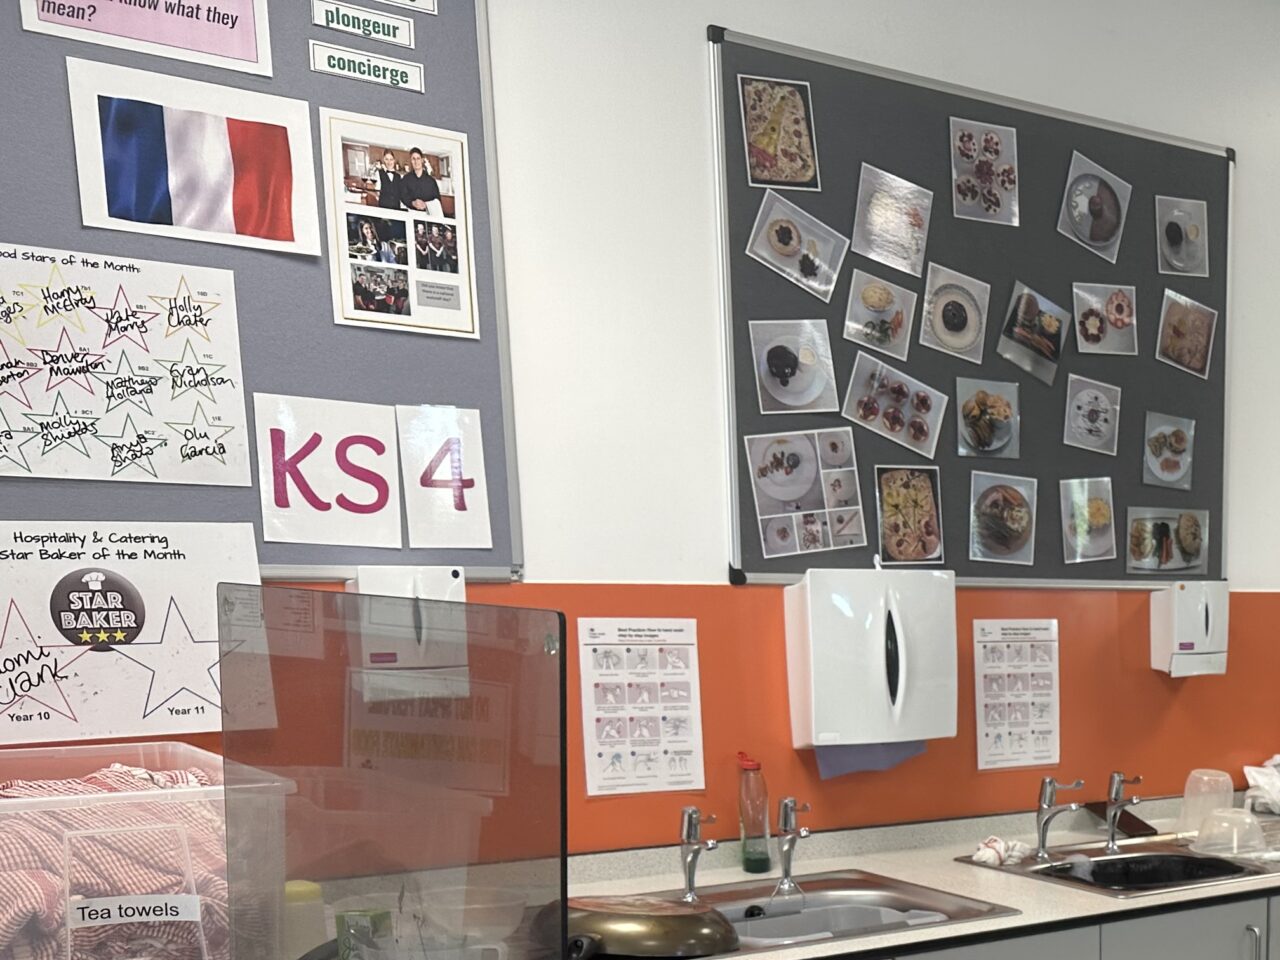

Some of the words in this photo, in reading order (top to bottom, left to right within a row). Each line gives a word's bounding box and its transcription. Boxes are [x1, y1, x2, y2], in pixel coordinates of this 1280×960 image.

[41, 0, 96, 21] mean?
[164, 0, 201, 20] what
[206, 9, 238, 29] they
[325, 7, 399, 38] plongeur
[327, 55, 408, 86] concierge
[0, 249, 17, 258] od
[22, 252, 56, 263] Stars
[61, 255, 76, 265] of
[81, 259, 99, 268] the
[0, 302, 23, 323] gers
[169, 296, 202, 317] Holly
[106, 308, 141, 324] Kate
[168, 313, 212, 328] Chater
[171, 374, 235, 390] Nicholson
[106, 386, 153, 400] Holland
[40, 415, 79, 432] Molly
[185, 427, 209, 440] Olu
[112, 434, 147, 454] Anya
[181, 440, 226, 460] Garcia
[270, 427, 390, 514] KS
[420, 437, 475, 511] 4
[14, 532, 86, 548] Hospitality
[92, 532, 103, 543] &
[109, 533, 168, 548] Catering
[0, 549, 33, 560] Star
[40, 550, 86, 560] Baker
[92, 548, 110, 560] of
[116, 550, 137, 560] the
[143, 550, 186, 560] Month
[69, 591, 122, 609] STAR
[61, 611, 137, 628] BAKER
[0, 646, 50, 674] omi
[37, 712, 50, 720] 10
[168, 707, 191, 716] Year
[194, 706, 205, 715] 11
[77, 906, 111, 921] Tea
[118, 902, 179, 918] towels
